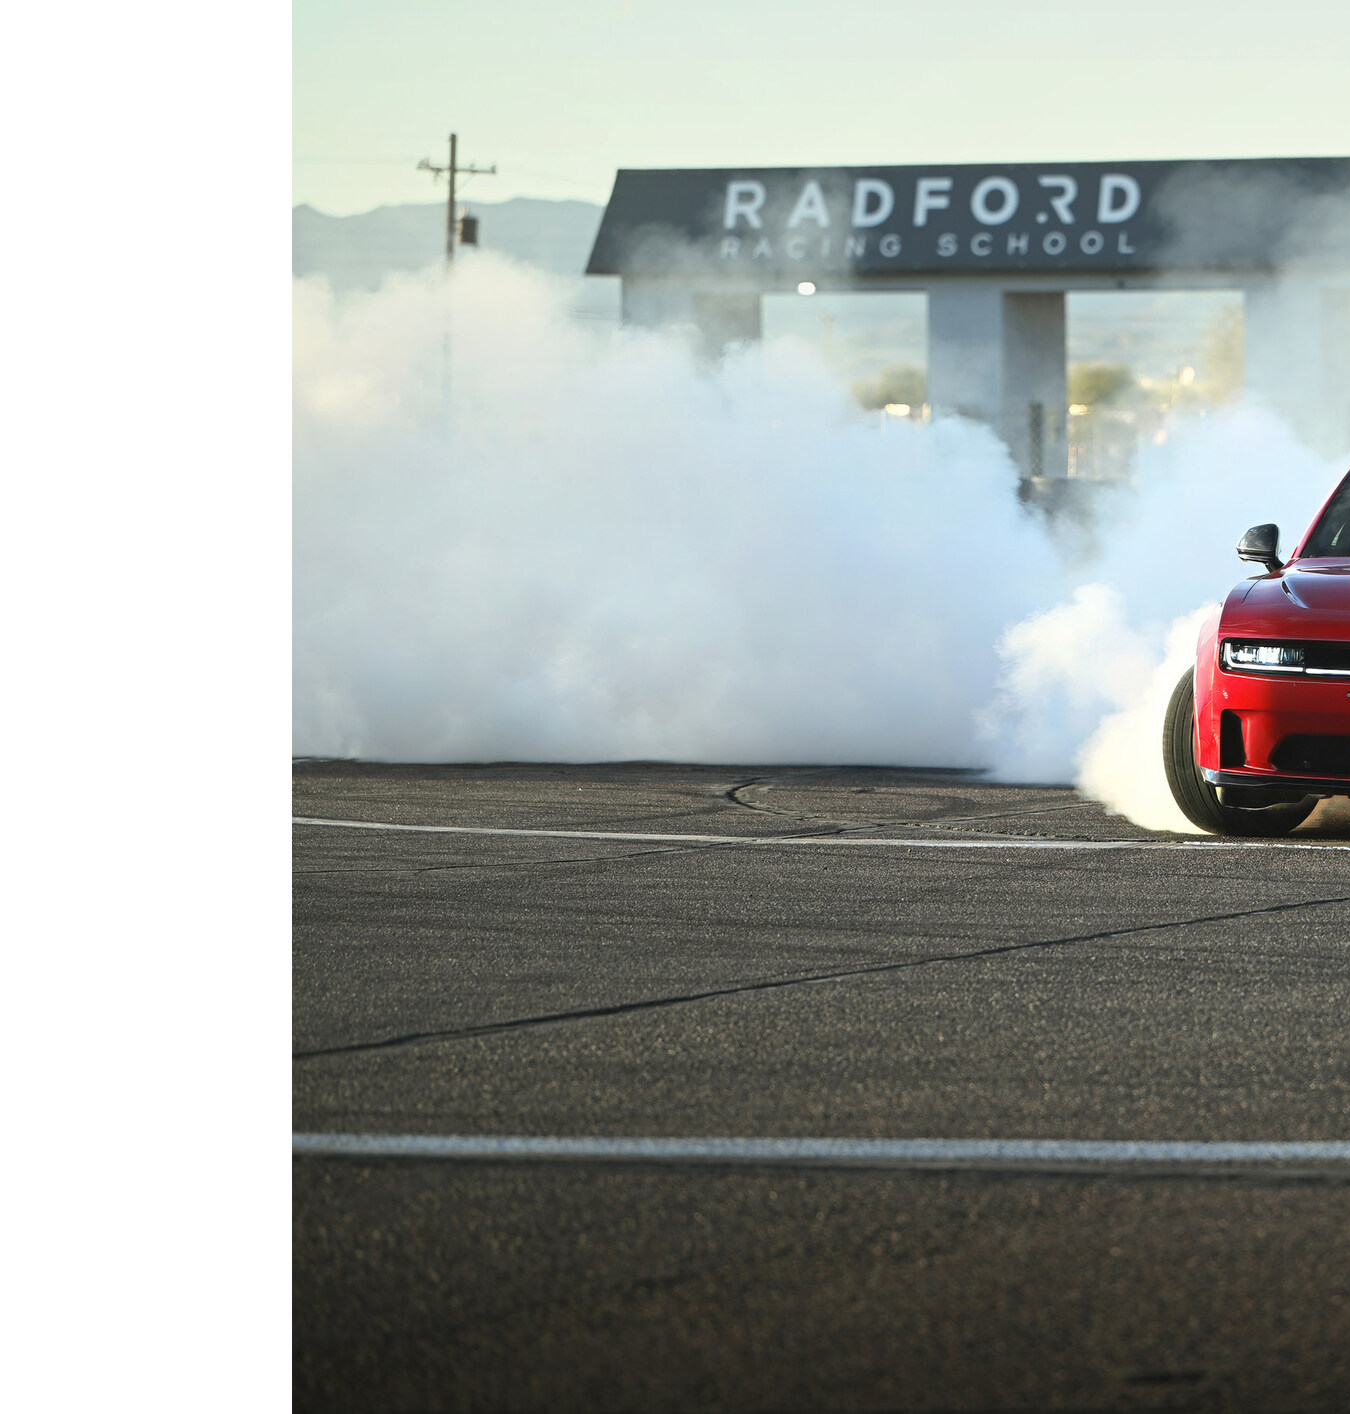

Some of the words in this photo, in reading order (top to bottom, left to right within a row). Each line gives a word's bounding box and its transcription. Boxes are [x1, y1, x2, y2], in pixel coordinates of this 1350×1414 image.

[724, 174, 1142, 228] RADFORD
[720, 231, 902, 259] RACING
[936, 229, 1138, 257] SCHOOL
